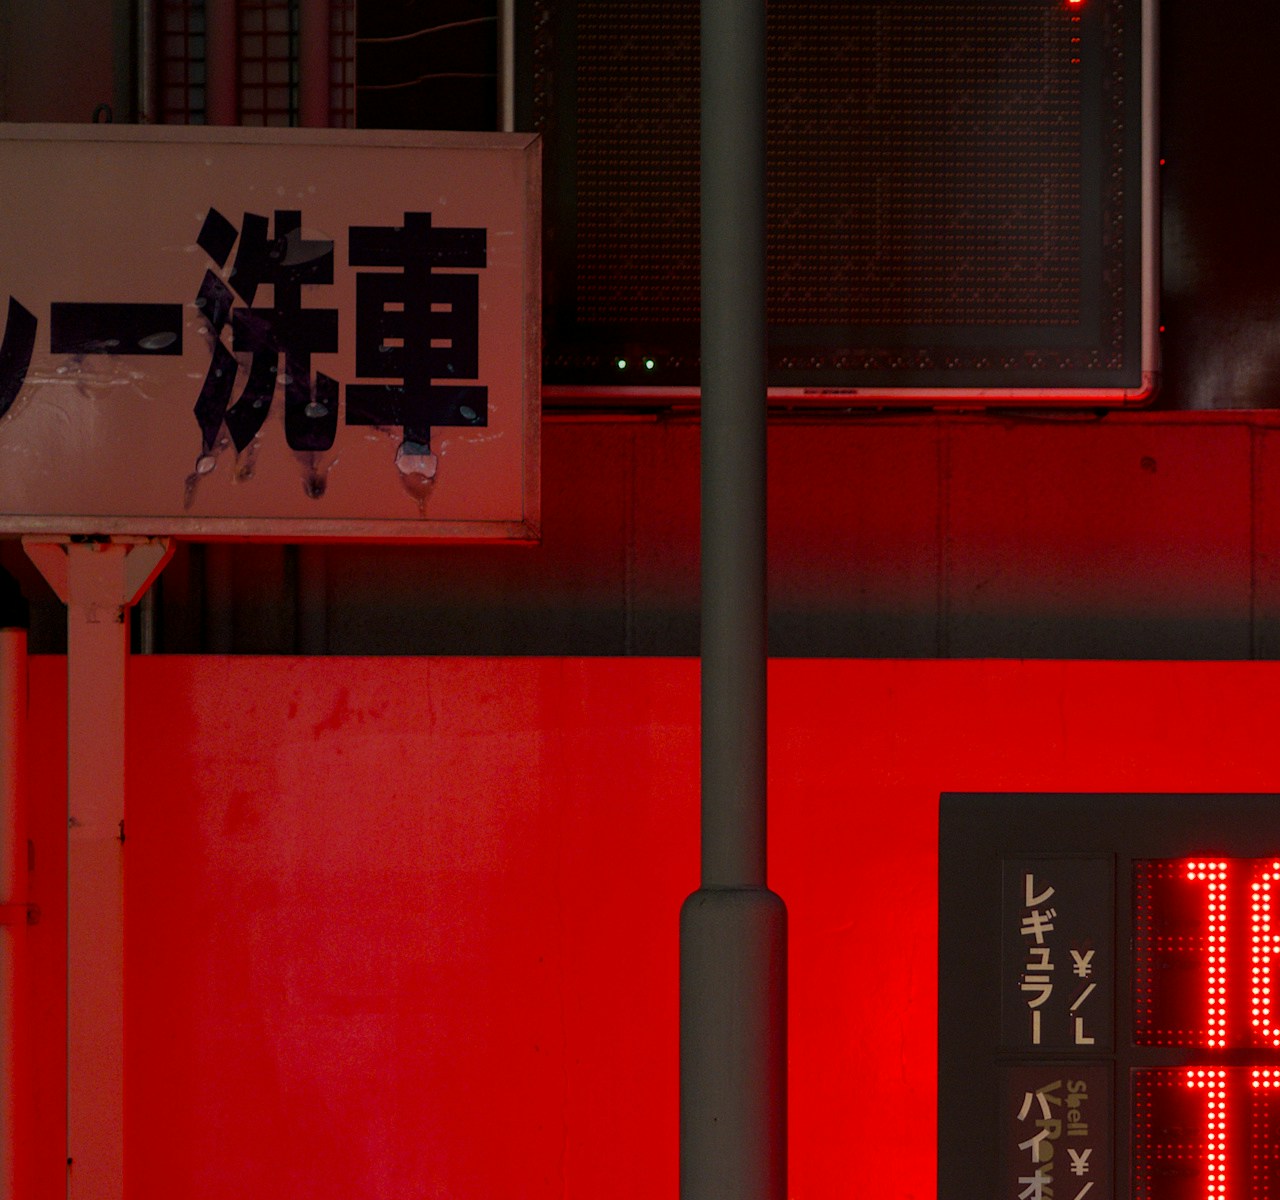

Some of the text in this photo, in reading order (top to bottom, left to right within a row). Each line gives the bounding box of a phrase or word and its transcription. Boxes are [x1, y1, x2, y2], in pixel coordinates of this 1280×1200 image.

[1020, 873, 1058, 1045] レギュラー
[1066, 1079, 1089, 1136] Shell
